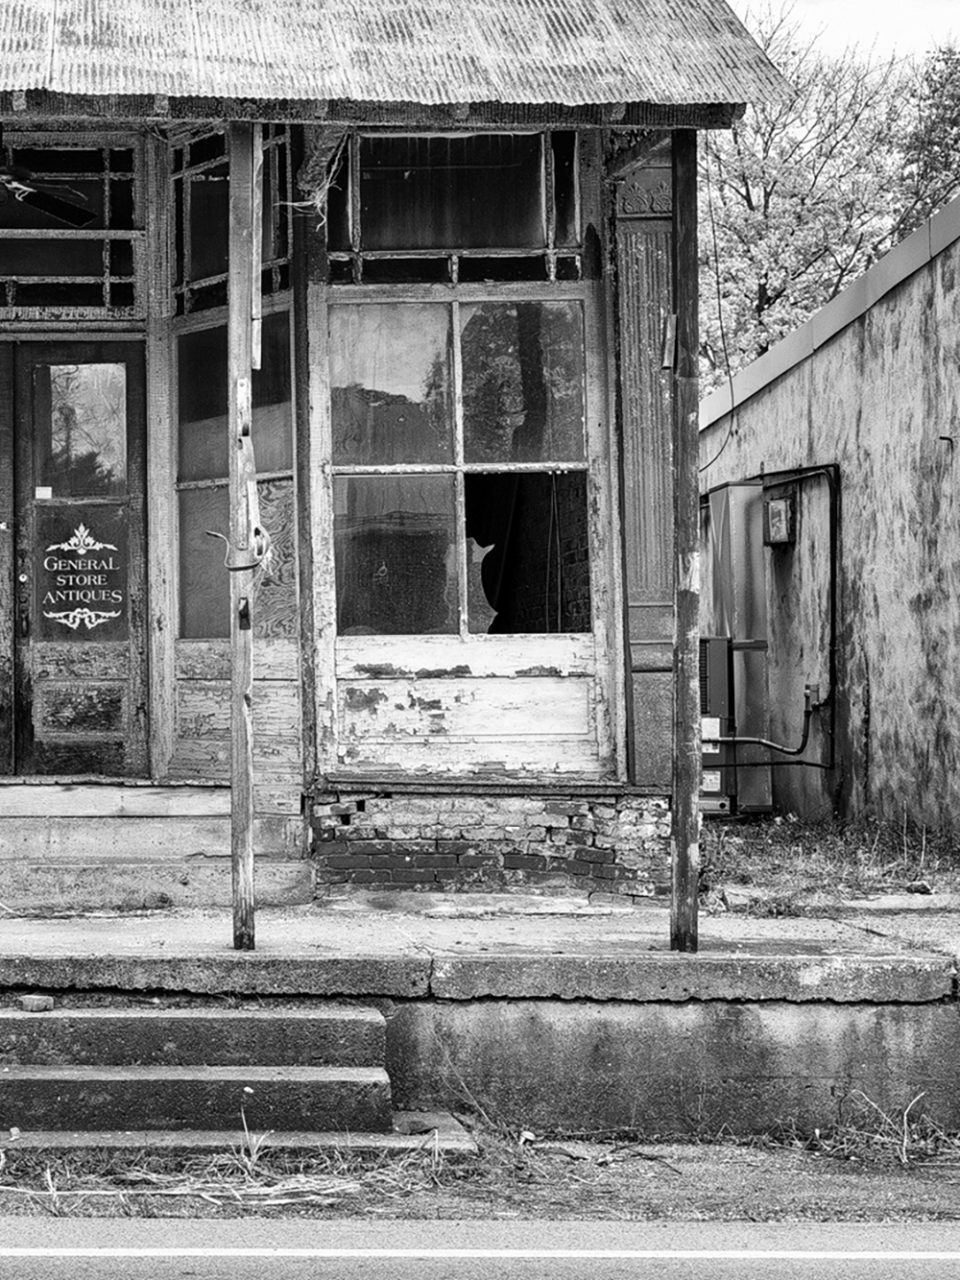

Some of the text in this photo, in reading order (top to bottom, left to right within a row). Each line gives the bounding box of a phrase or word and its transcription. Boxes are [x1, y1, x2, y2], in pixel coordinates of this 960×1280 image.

[43, 555, 121, 571] GENERAL
[56, 574, 108, 586] STORE
[42, 589, 123, 604] ANTIQUES
